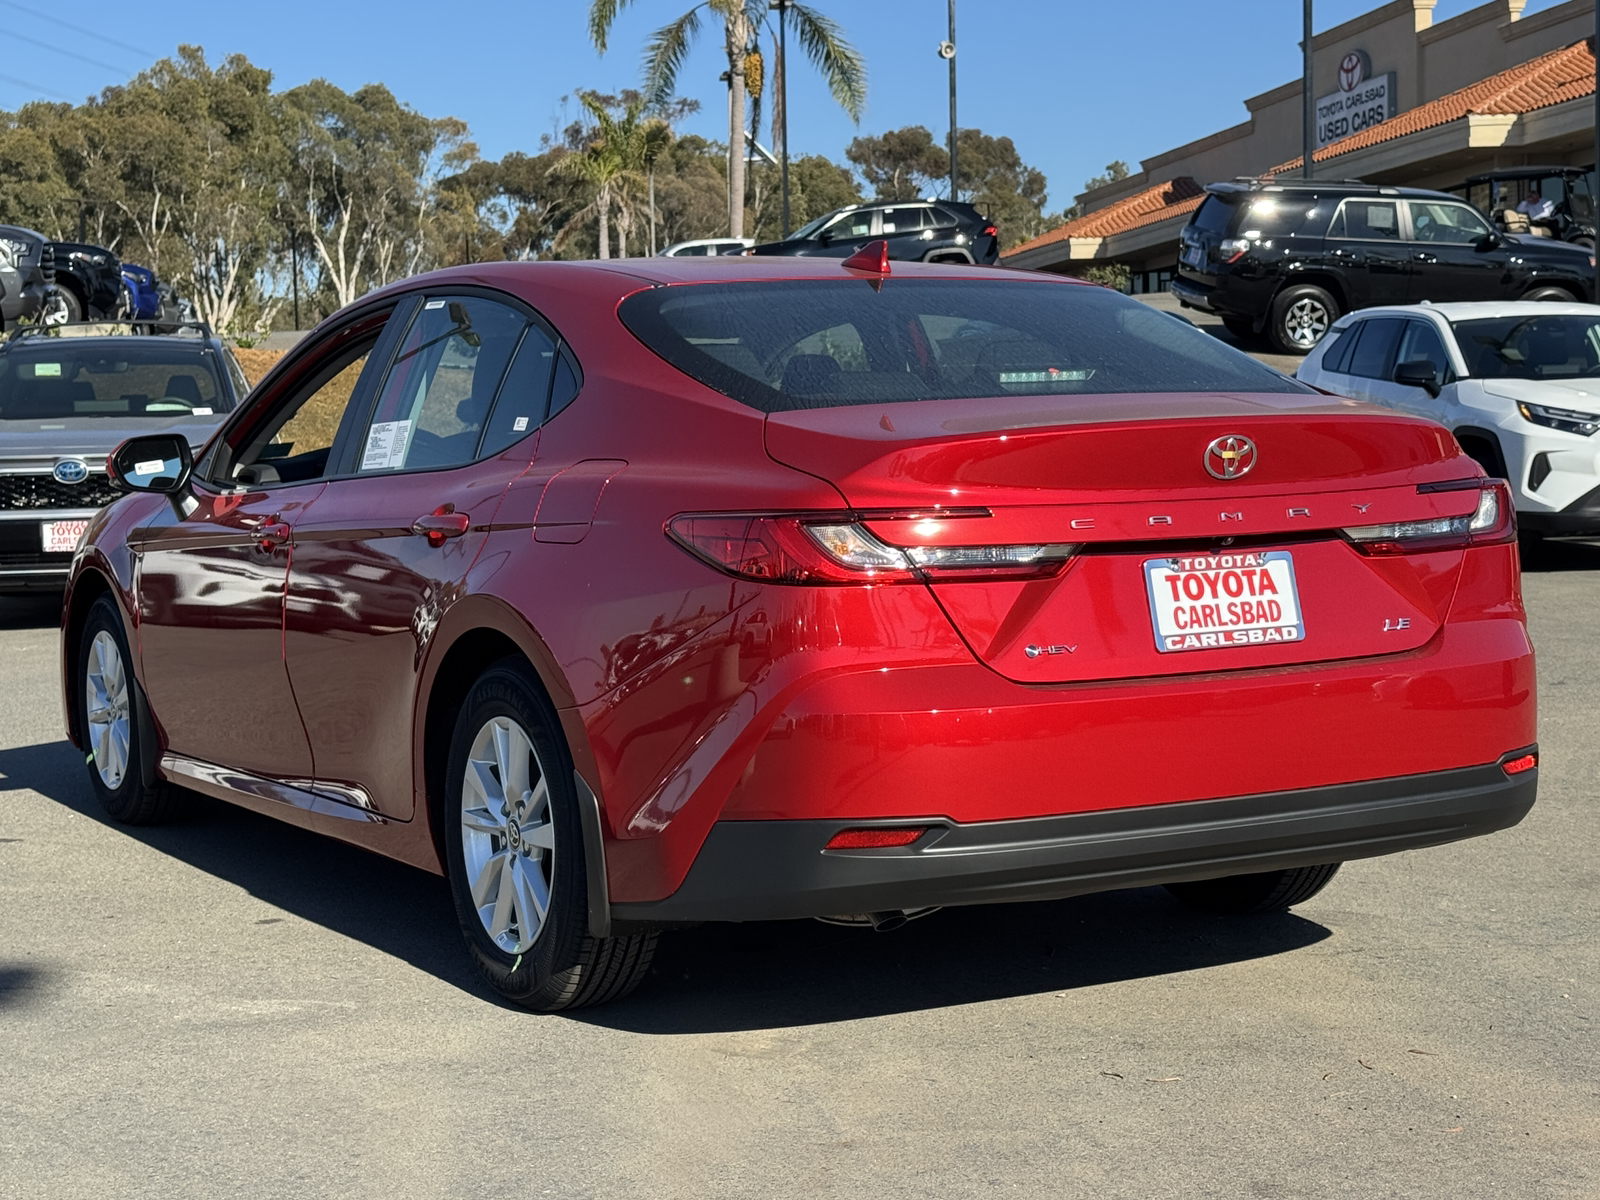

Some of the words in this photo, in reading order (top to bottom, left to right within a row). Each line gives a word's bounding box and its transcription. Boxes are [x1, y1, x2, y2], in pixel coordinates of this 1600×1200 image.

[1318, 100, 1344, 119] TOYOTA
[1345, 85, 1386, 110] CARLSBAD
[1319, 117, 1349, 143] USED
[1352, 104, 1384, 132] CARS
[1069, 502, 1373, 530] CAMRY
[50, 525, 86, 536] TOYO
[1181, 554, 1258, 571] TOYOTA
[1165, 568, 1279, 602] TOYOTA
[1173, 599, 1282, 630] CARLSBAD
[1383, 618, 1411, 632] LE
[1039, 644, 1078, 655] HEV
[1164, 626, 1299, 650] CARLSBAD
